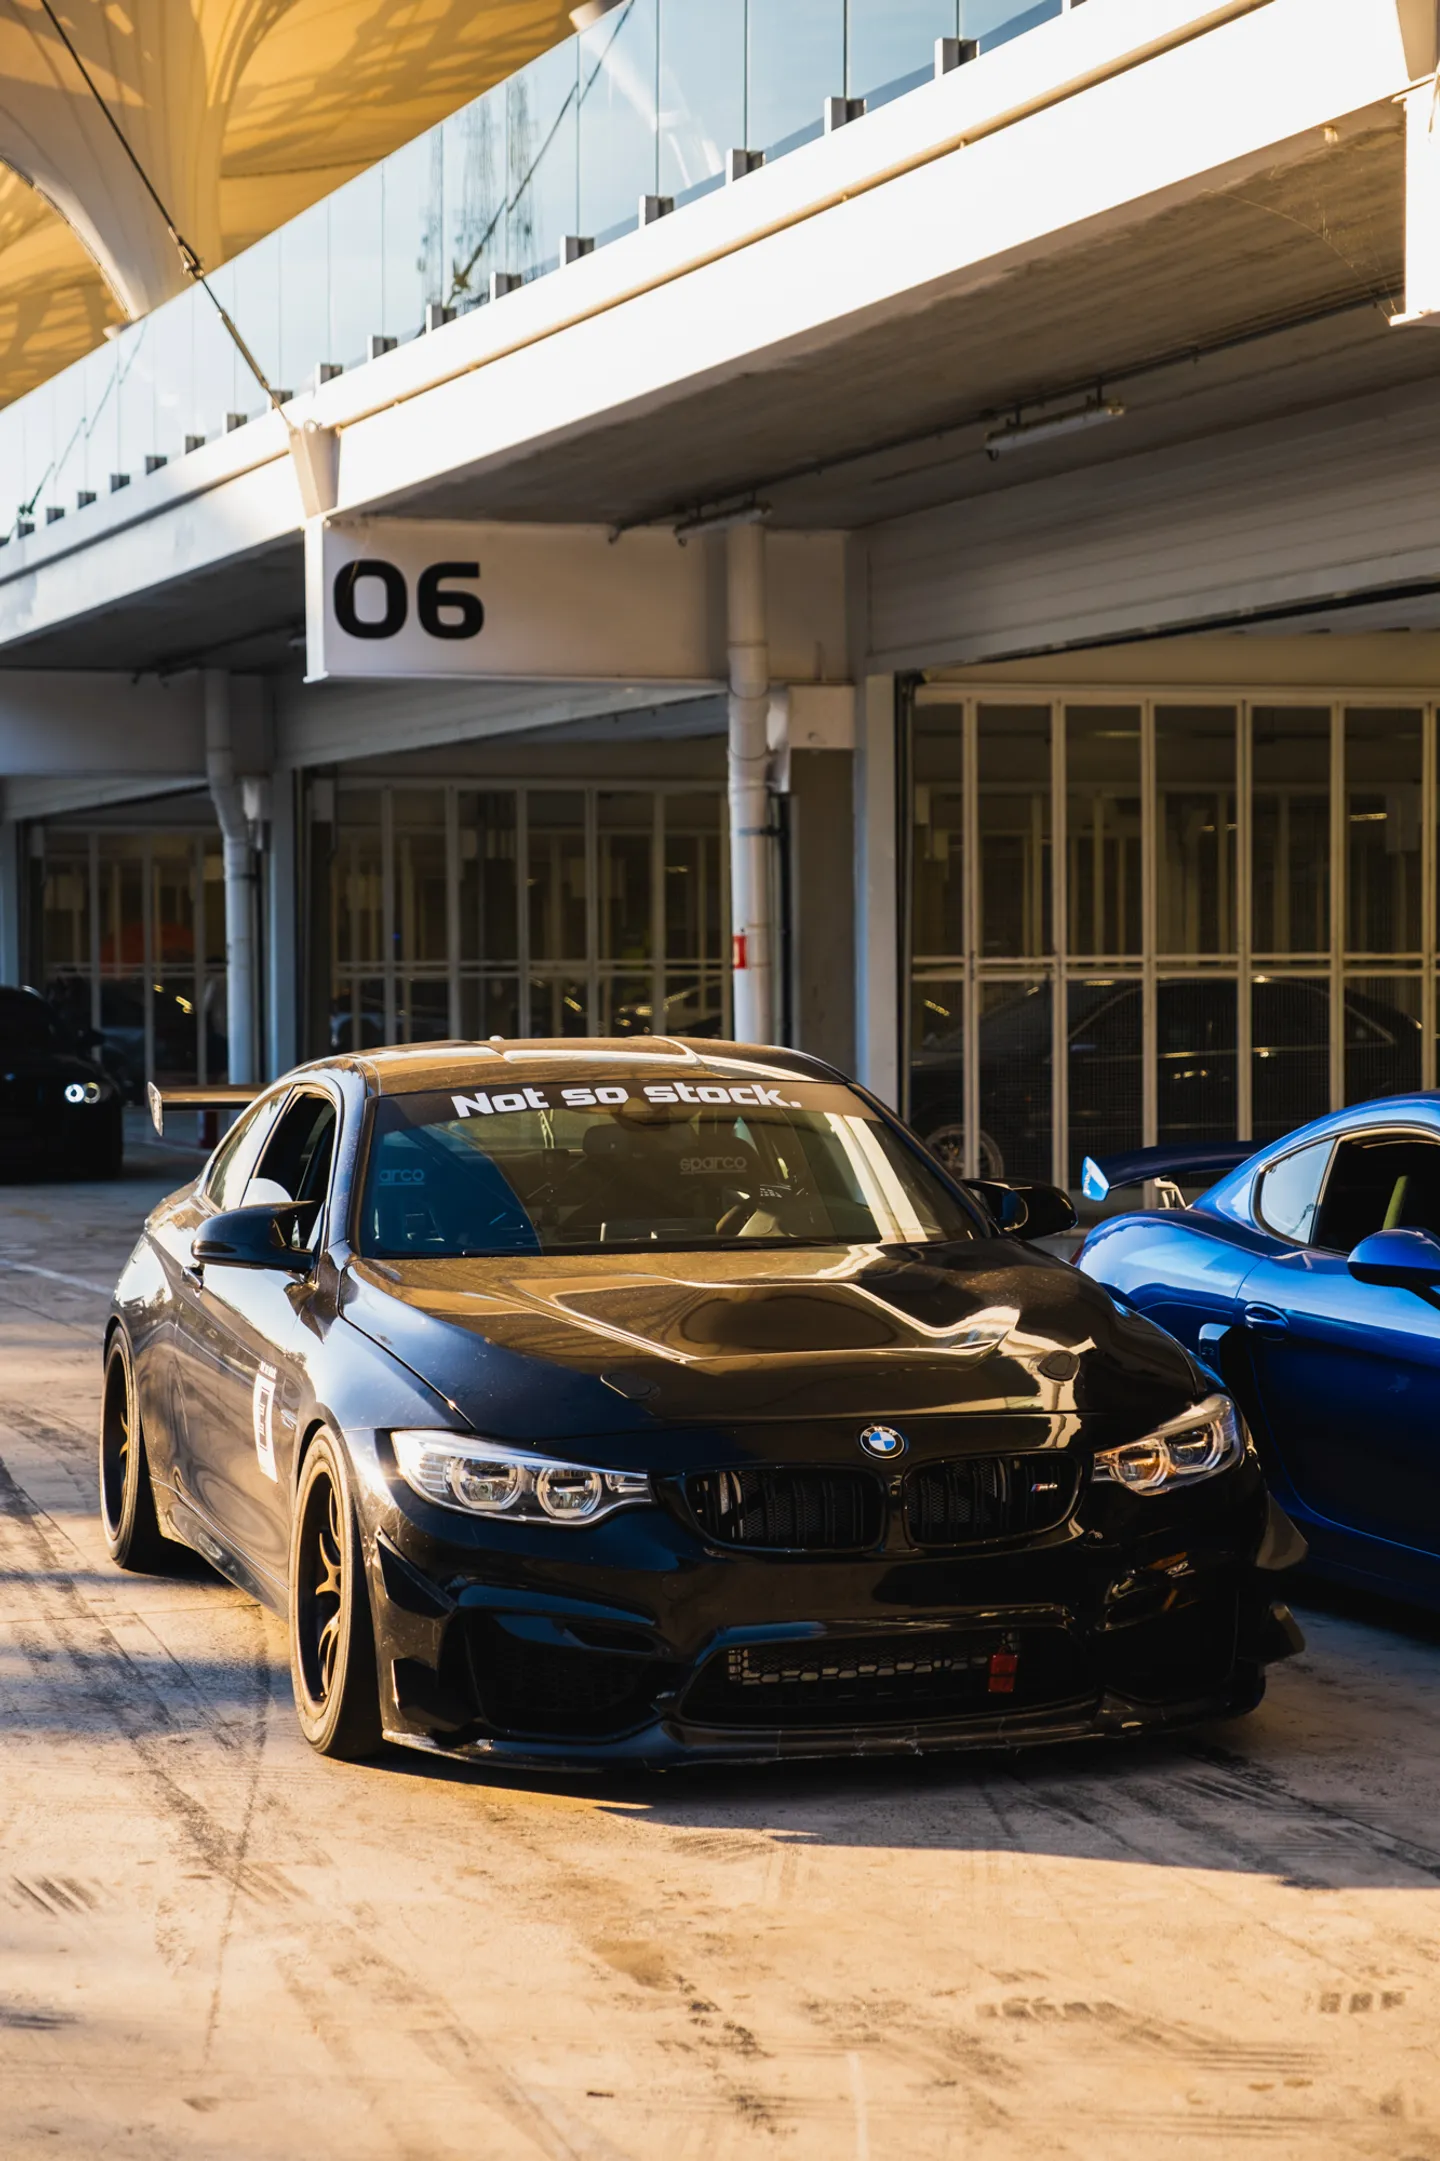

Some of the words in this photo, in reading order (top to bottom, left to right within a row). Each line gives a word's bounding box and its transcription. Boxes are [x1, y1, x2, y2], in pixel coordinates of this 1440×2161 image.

[333, 559, 484, 640] 06
[451, 1087, 549, 1118] Not
[561, 1087, 629, 1106] so
[643, 1082, 802, 1107] stock.
[379, 1168, 425, 1184] arco
[680, 1156, 747, 1174] sparco
